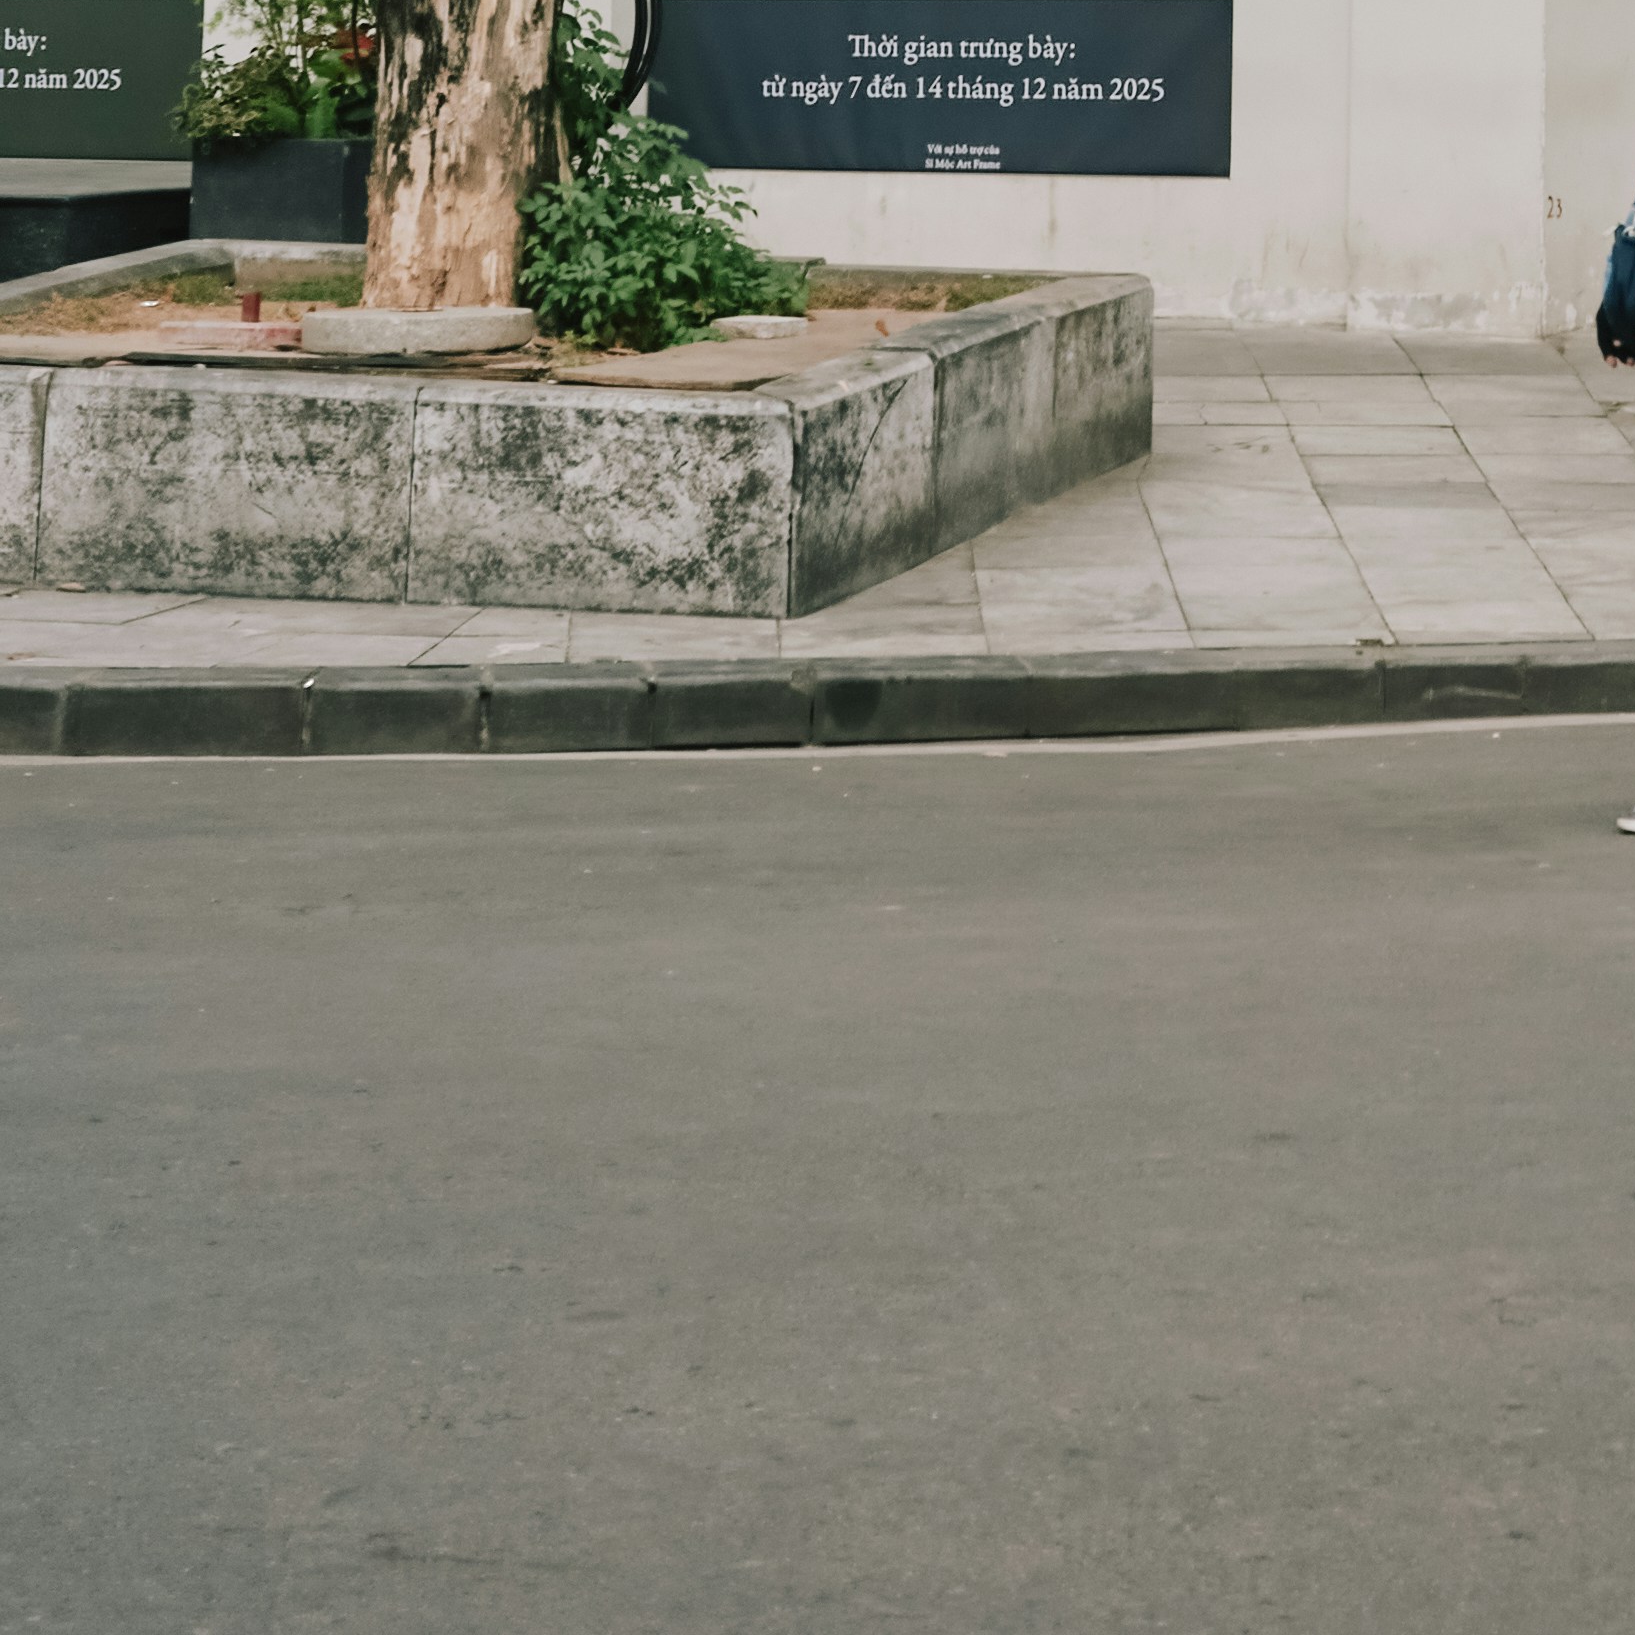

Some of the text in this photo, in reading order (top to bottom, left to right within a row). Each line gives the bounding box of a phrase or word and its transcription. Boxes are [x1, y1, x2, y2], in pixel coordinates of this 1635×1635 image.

[5, 28, 46, 56] bày:
[848, 34, 1075, 66] Thời gian trưng bày:
[24, 69, 67, 88] năm
[73, 69, 121, 90] 2025
[762, 74, 1164, 107] từ ngày 7 đến 14 tháng 12 năm 2025
[956, 159, 971, 169] Art
[973, 159, 1000, 169] Frame
